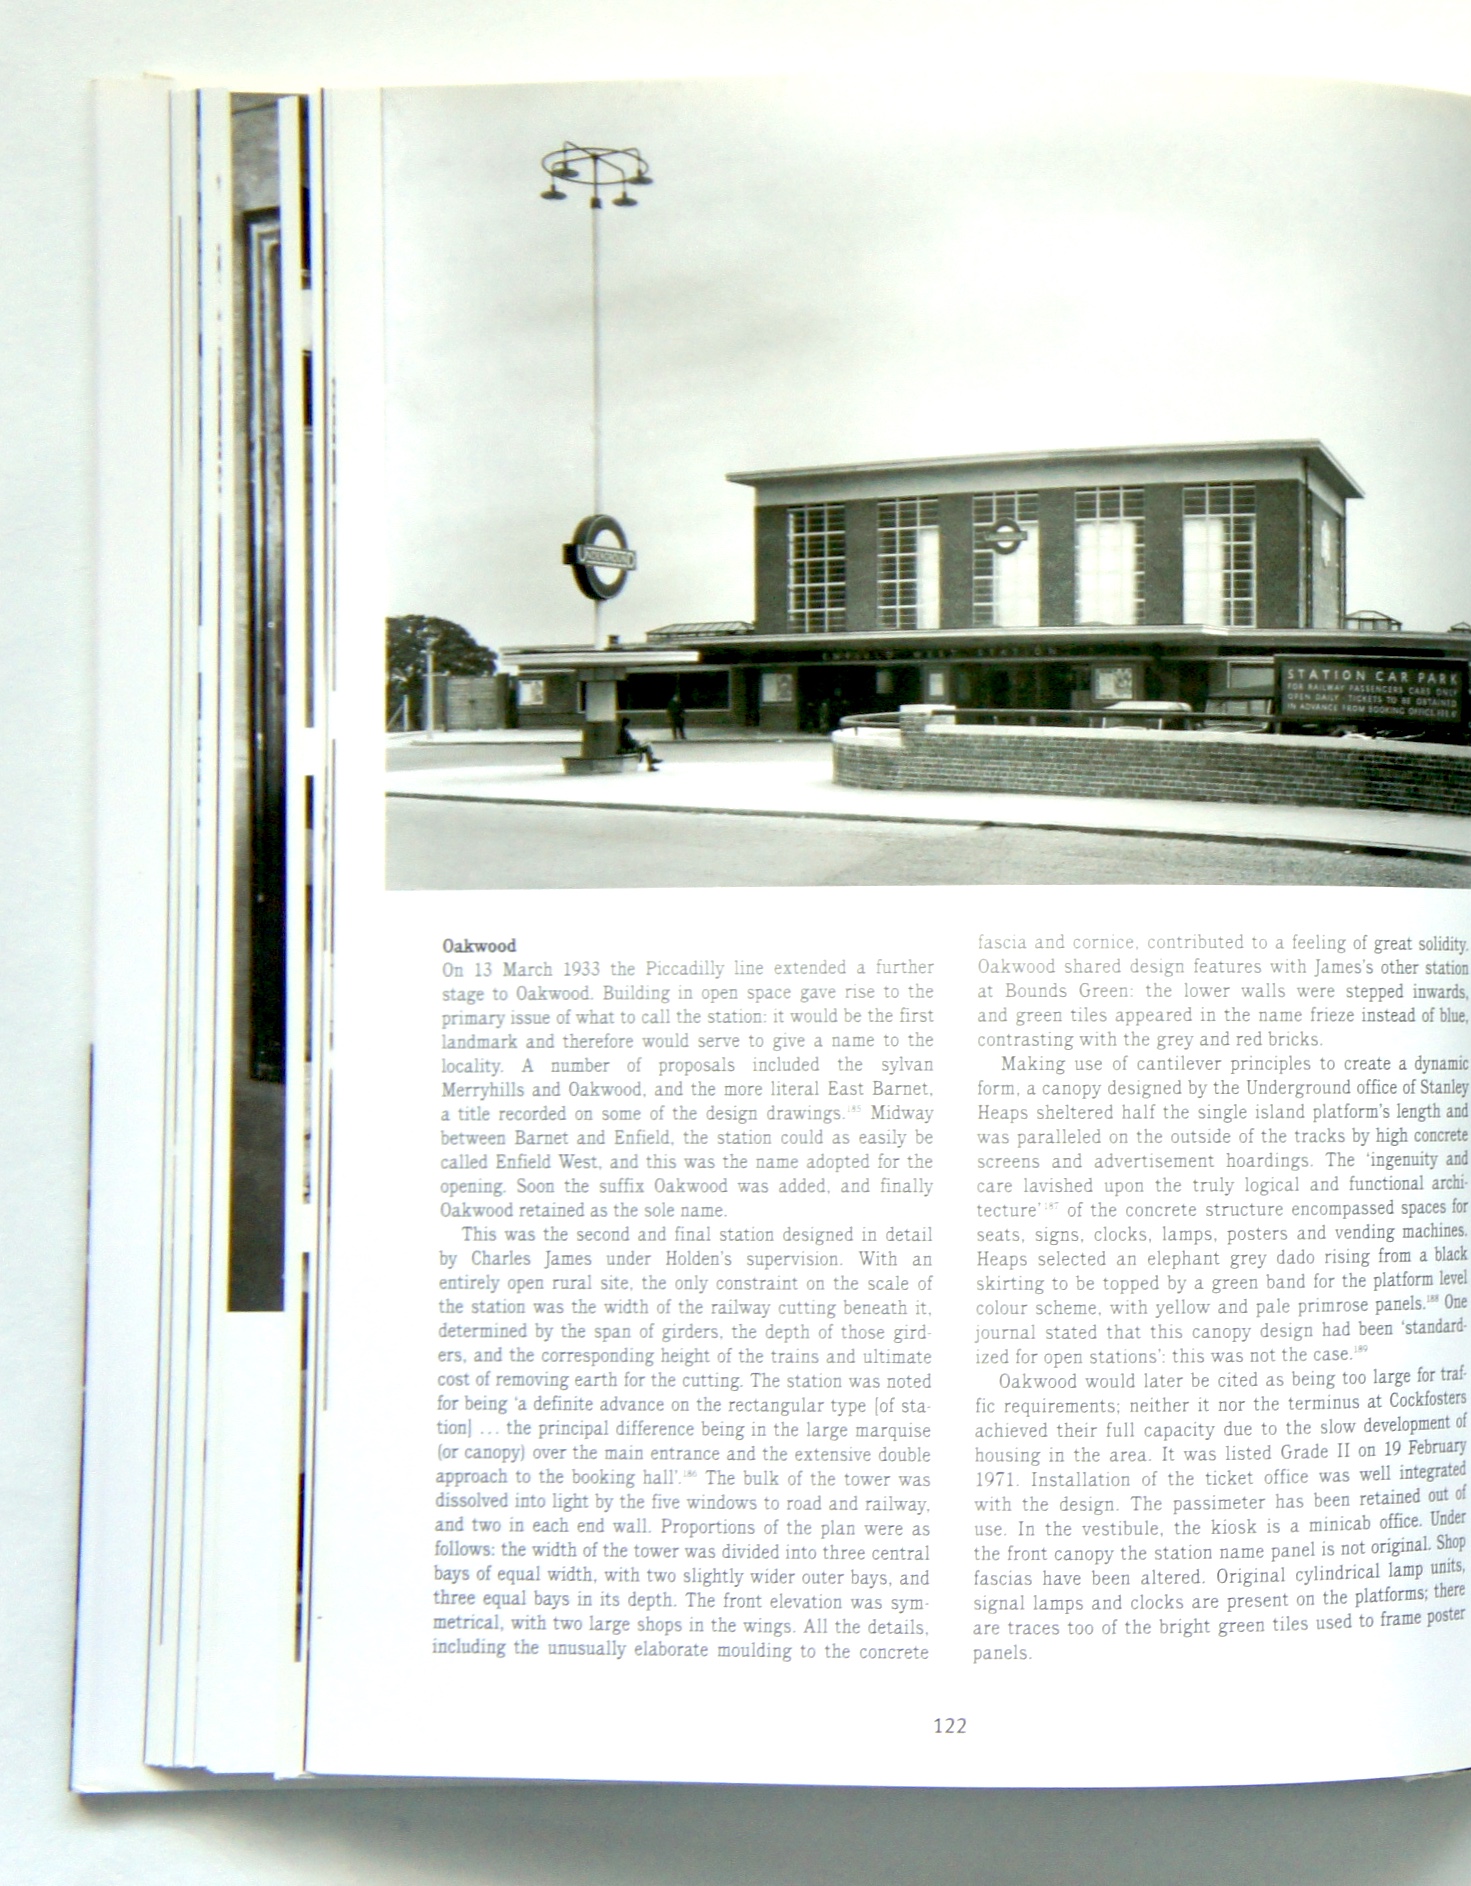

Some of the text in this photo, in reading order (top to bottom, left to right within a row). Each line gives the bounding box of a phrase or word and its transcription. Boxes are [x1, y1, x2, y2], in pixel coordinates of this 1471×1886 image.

[1287, 668, 1458, 686] STATION CAR PARK
[1287, 682, 1304, 691] FOR
[1308, 683, 1345, 692] RAILWAY
[1348, 684, 1404, 694] PASSENGERS
[1408, 686, 1431, 696] CARS
[1287, 692, 1312, 701] OPEN
[1315, 693, 1340, 702] DAILY
[1348, 694, 1383, 703] TICKETS
[1299, 703, 1338, 712] ADVANCE
[441, 937, 518, 954] Oakwood
[441, 958, 935, 979] On 13 March 1933 the Piccadilly line extended a further
[977, 982, 1470, 1003] at Bounds Green: the lower walls were stepped inwards,
[439, 1201, 728, 1218] Oakwood retained as the sole name.
[976, 1221, 1469, 1246] seats, signs, clocks, lamps, posters and vending machines.
[974, 1438, 1468, 1467] housing in the area. It was listed Grade II on 19 February
[431, 1637, 930, 1663] including the unusually elaborate moulding to the concrete
[972, 1643, 1033, 1665] panels.
[933, 1717, 968, 1734] 122
